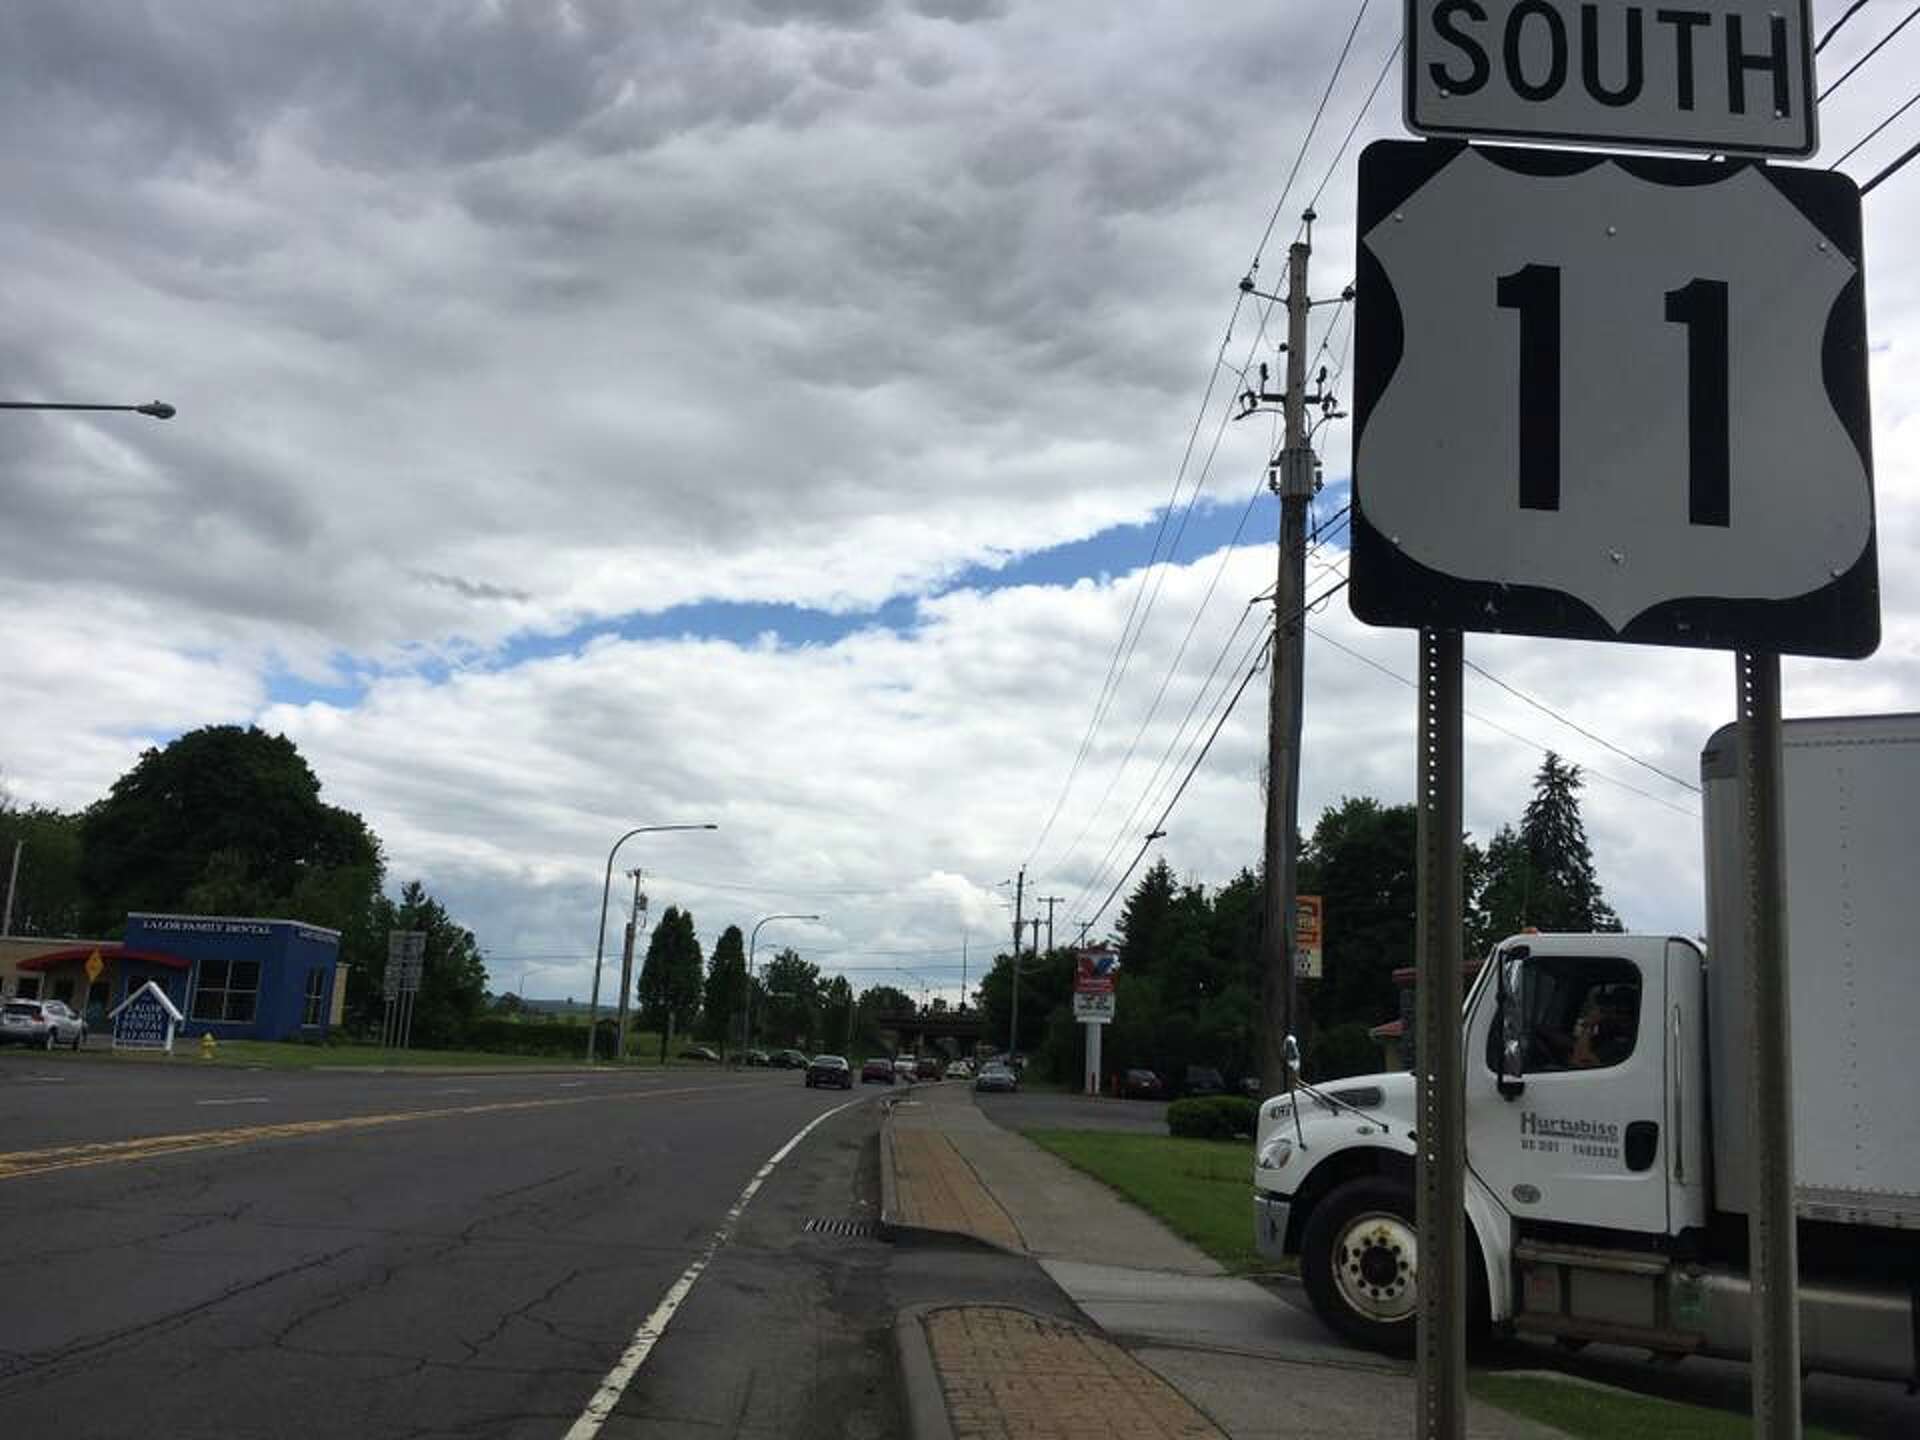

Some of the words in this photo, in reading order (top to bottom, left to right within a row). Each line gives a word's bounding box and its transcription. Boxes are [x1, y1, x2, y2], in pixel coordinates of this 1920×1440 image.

[1428, 0, 1791, 119] SOUTH
[1497, 263, 1731, 528] 11
[225, 924, 272, 935] DENTAL
[1520, 1111, 1619, 1136] Hurtubise
